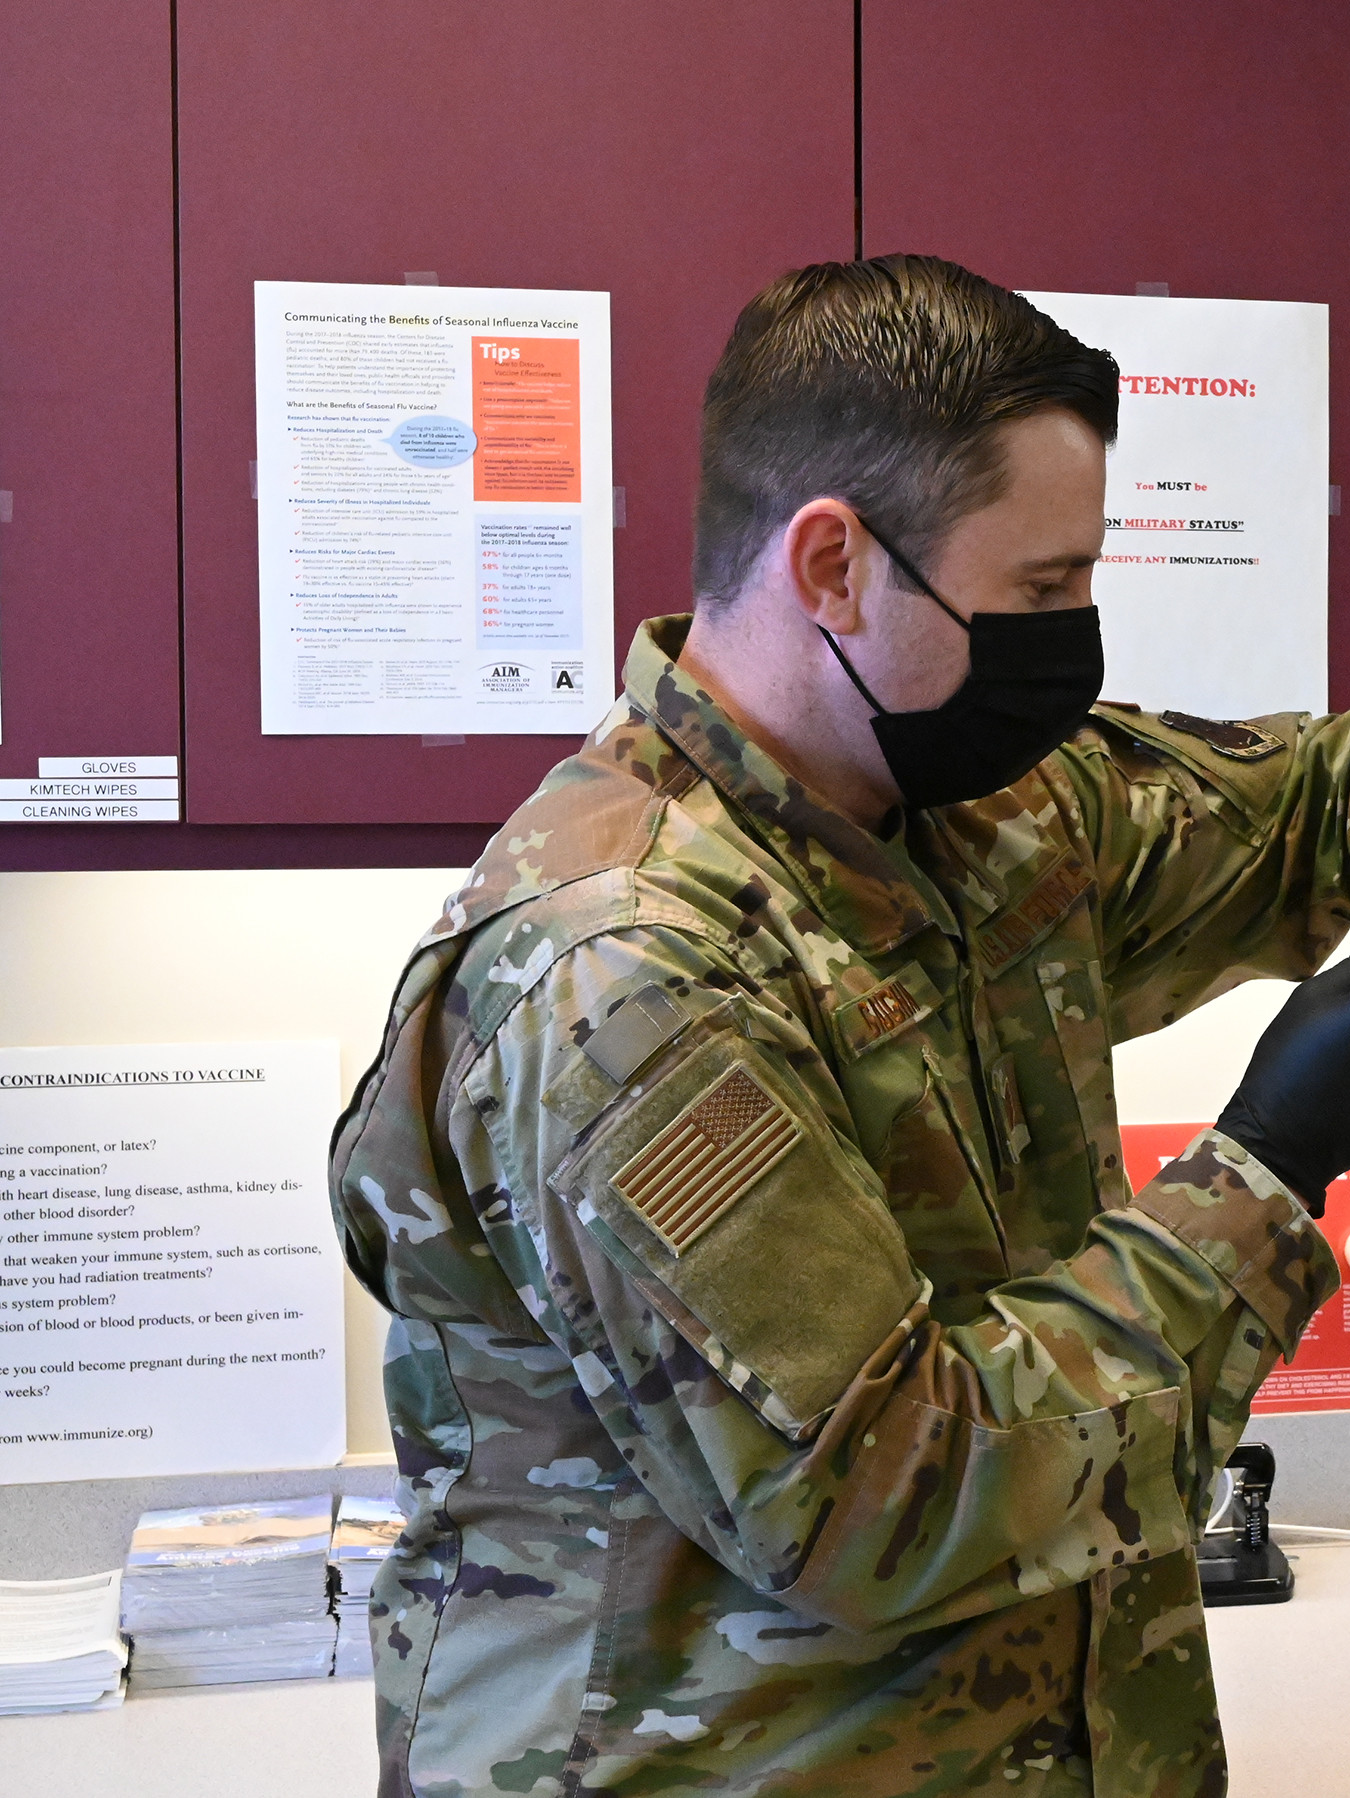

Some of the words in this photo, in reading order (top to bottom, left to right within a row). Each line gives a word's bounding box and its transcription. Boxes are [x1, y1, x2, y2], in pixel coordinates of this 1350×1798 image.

[285, 312, 367, 326] Communicating
[370, 315, 386, 323] the
[389, 315, 429, 324] Benefits
[433, 316, 443, 325] of
[445, 317, 489, 326] Seasonal
[493, 318, 538, 327] Influenza
[541, 320, 578, 329] Vaccine
[480, 344, 520, 363] Tips
[1118, 376, 1256, 397] TENTION:
[1157, 482, 1191, 490] MUST
[1194, 483, 1207, 491] be
[1124, 518, 1186, 528] MILITARY
[1170, 556, 1259, 566] IMMUNIZATIONS!!
[492, 667, 520, 677] AIM
[82, 762, 136, 773] GLOVES
[31, 785, 89, 795] KIMTECH
[94, 785, 137, 795] WIPES
[23, 806, 91, 817] CLEANING
[95, 806, 137, 817] WIPES
[1, 1071, 168, 1087] CONTRAINDICATIONS
[173, 1070, 193, 1082] TO
[199, 1068, 265, 1081] VACCINE
[28, 1144, 99, 1156] component,
[121, 1140, 156, 1151] latex?
[30, 1164, 107, 1176] vaccination?
[18, 1189, 48, 1200] heart
[52, 1188, 100, 1199] disease,
[105, 1186, 131, 1199] lung
[135, 1185, 182, 1195] disease,
[187, 1183, 232, 1194] asthma,
[237, 1181, 276, 1193] kidney
[281, 1180, 302, 1190] dis-
[4, 1209, 35, 1220] other
[40, 1207, 73, 1219] blood
[78, 1205, 134, 1217] disorder?
[8, 1232, 39, 1243] other
[44, 1231, 93, 1241] immune
[98, 1231, 138, 1242] system
[144, 1225, 200, 1241] problem?
[4, 1256, 26, 1266] that
[31, 1254, 77, 1265] weaken
[82, 1255, 109, 1266] your
[114, 1251, 162, 1262] immune
[167, 1250, 212, 1262] system,
[217, 1246, 243, 1257] such
[264, 1244, 321, 1255] cortisone,
[0, 1276, 28, 1286] have
[32, 1277, 54, 1288] you
[59, 1273, 80, 1284] had
[86, 1271, 138, 1283] radiation
[143, 1267, 212, 1280] treatments?
[12, 1300, 53, 1311] system
[59, 1294, 115, 1310] problem?
[28, 1319, 42, 1331] of
[45, 1318, 79, 1330] blood
[101, 1316, 134, 1327] blood
[139, 1314, 194, 1329] products,
[198, 1315, 211, 1323] or
[215, 1312, 242, 1322] been
[247, 1310, 279, 1324] given
[284, 1309, 303, 1319] im-
[14, 1366, 36, 1377] you
[40, 1361, 74, 1373] could
[79, 1361, 125, 1371] become
[130, 1358, 182, 1372] pregnant
[187, 1354, 225, 1367] during
[230, 1353, 247, 1364] the
[252, 1353, 276, 1362] next
[282, 1349, 325, 1361] month?
[5, 1385, 49, 1397] weeks?
[27, 1426, 153, 1442] www.immunize.org)
